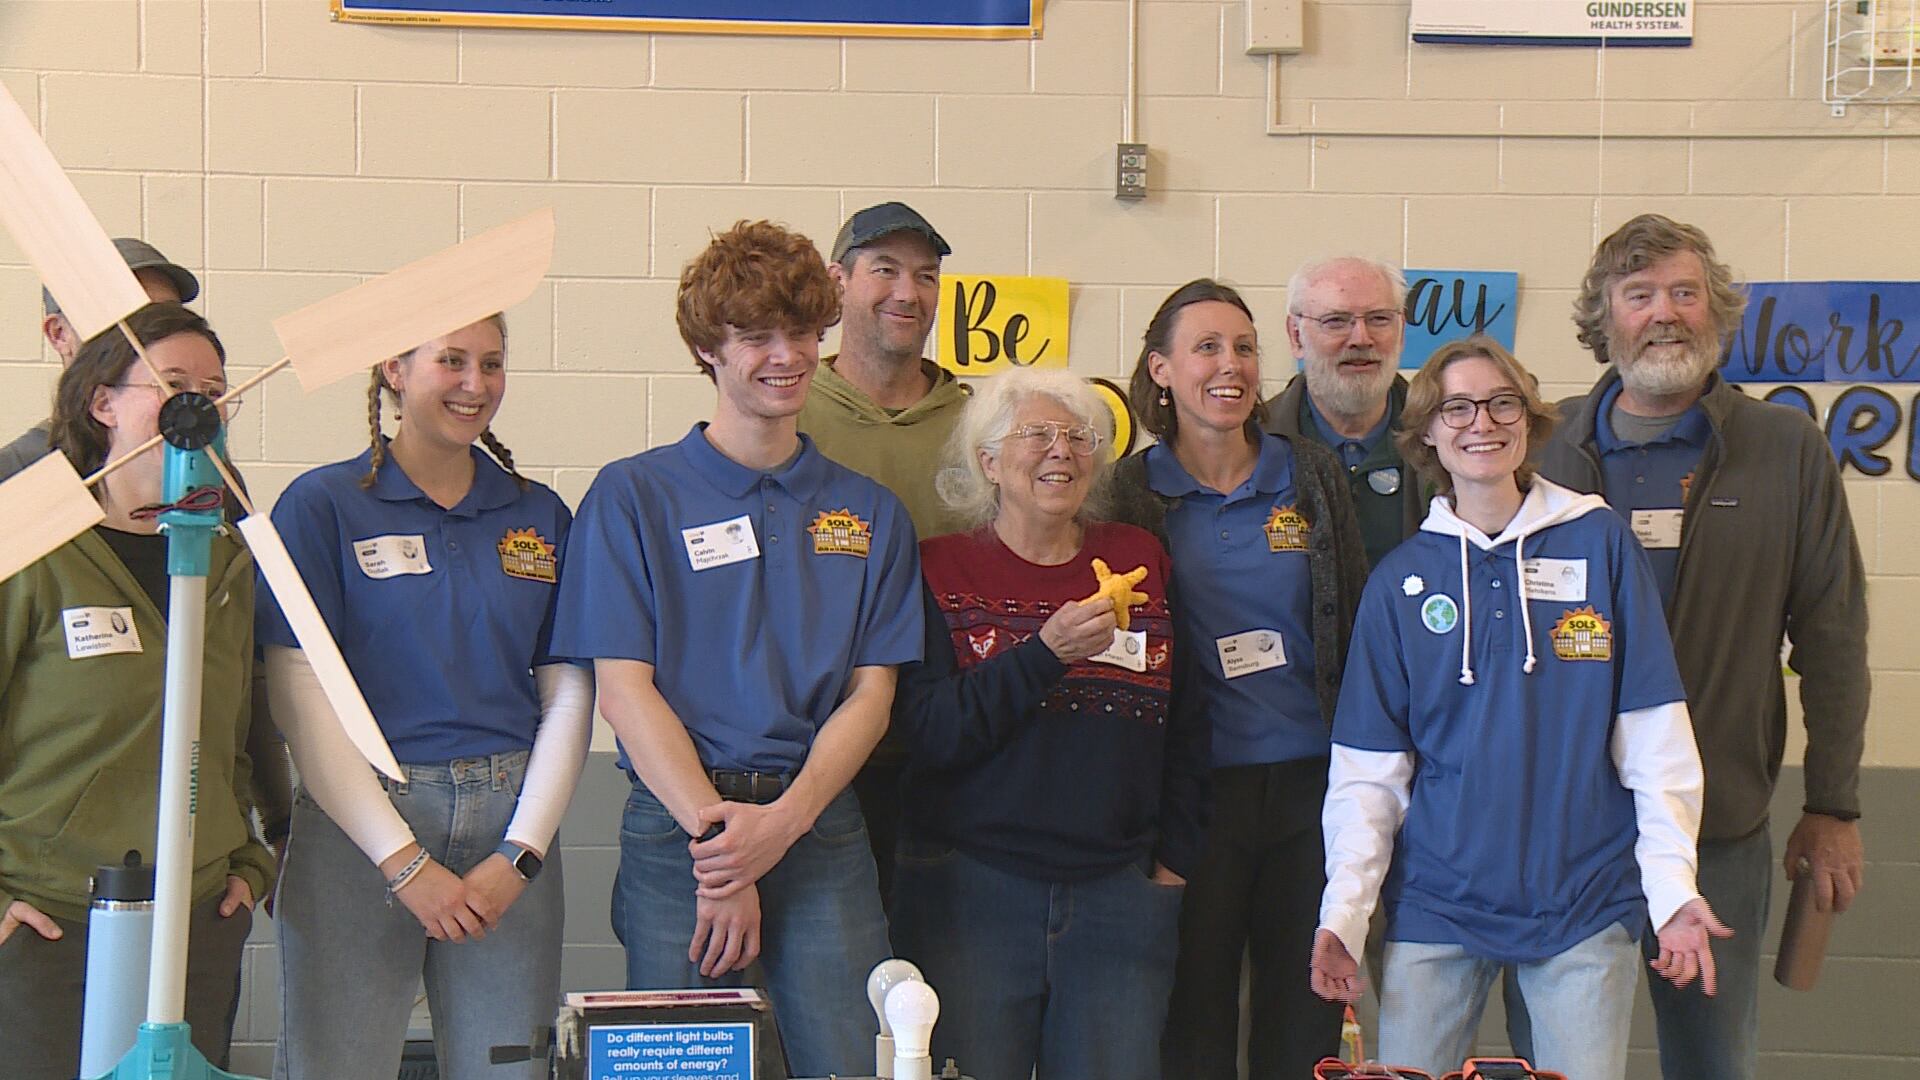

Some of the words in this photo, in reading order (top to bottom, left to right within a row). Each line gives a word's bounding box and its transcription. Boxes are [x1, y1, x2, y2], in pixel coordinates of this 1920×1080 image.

[1586, 2, 1687, 18] GUNDERSEN
[1590, 21, 1633, 30] HEALTH
[1404, 278, 1505, 336] ay
[953, 280, 1050, 367] Be
[826, 519, 853, 528] SOLS
[513, 540, 539, 550] SOLS
[1569, 620, 1597, 629] SOLS
[607, 1033, 624, 1044] Do
[626, 1032, 674, 1043] different
[676, 1030, 700, 1044] light
[703, 1030, 734, 1041] bulbs
[608, 1046, 640, 1059] really
[643, 1045, 683, 1058] require
[686, 1044, 734, 1056] different
[613, 1060, 664, 1071] amounts
[667, 1059, 678, 1070] of
[681, 1058, 728, 1071] energy?
[716, 1072, 739, 1080] and
